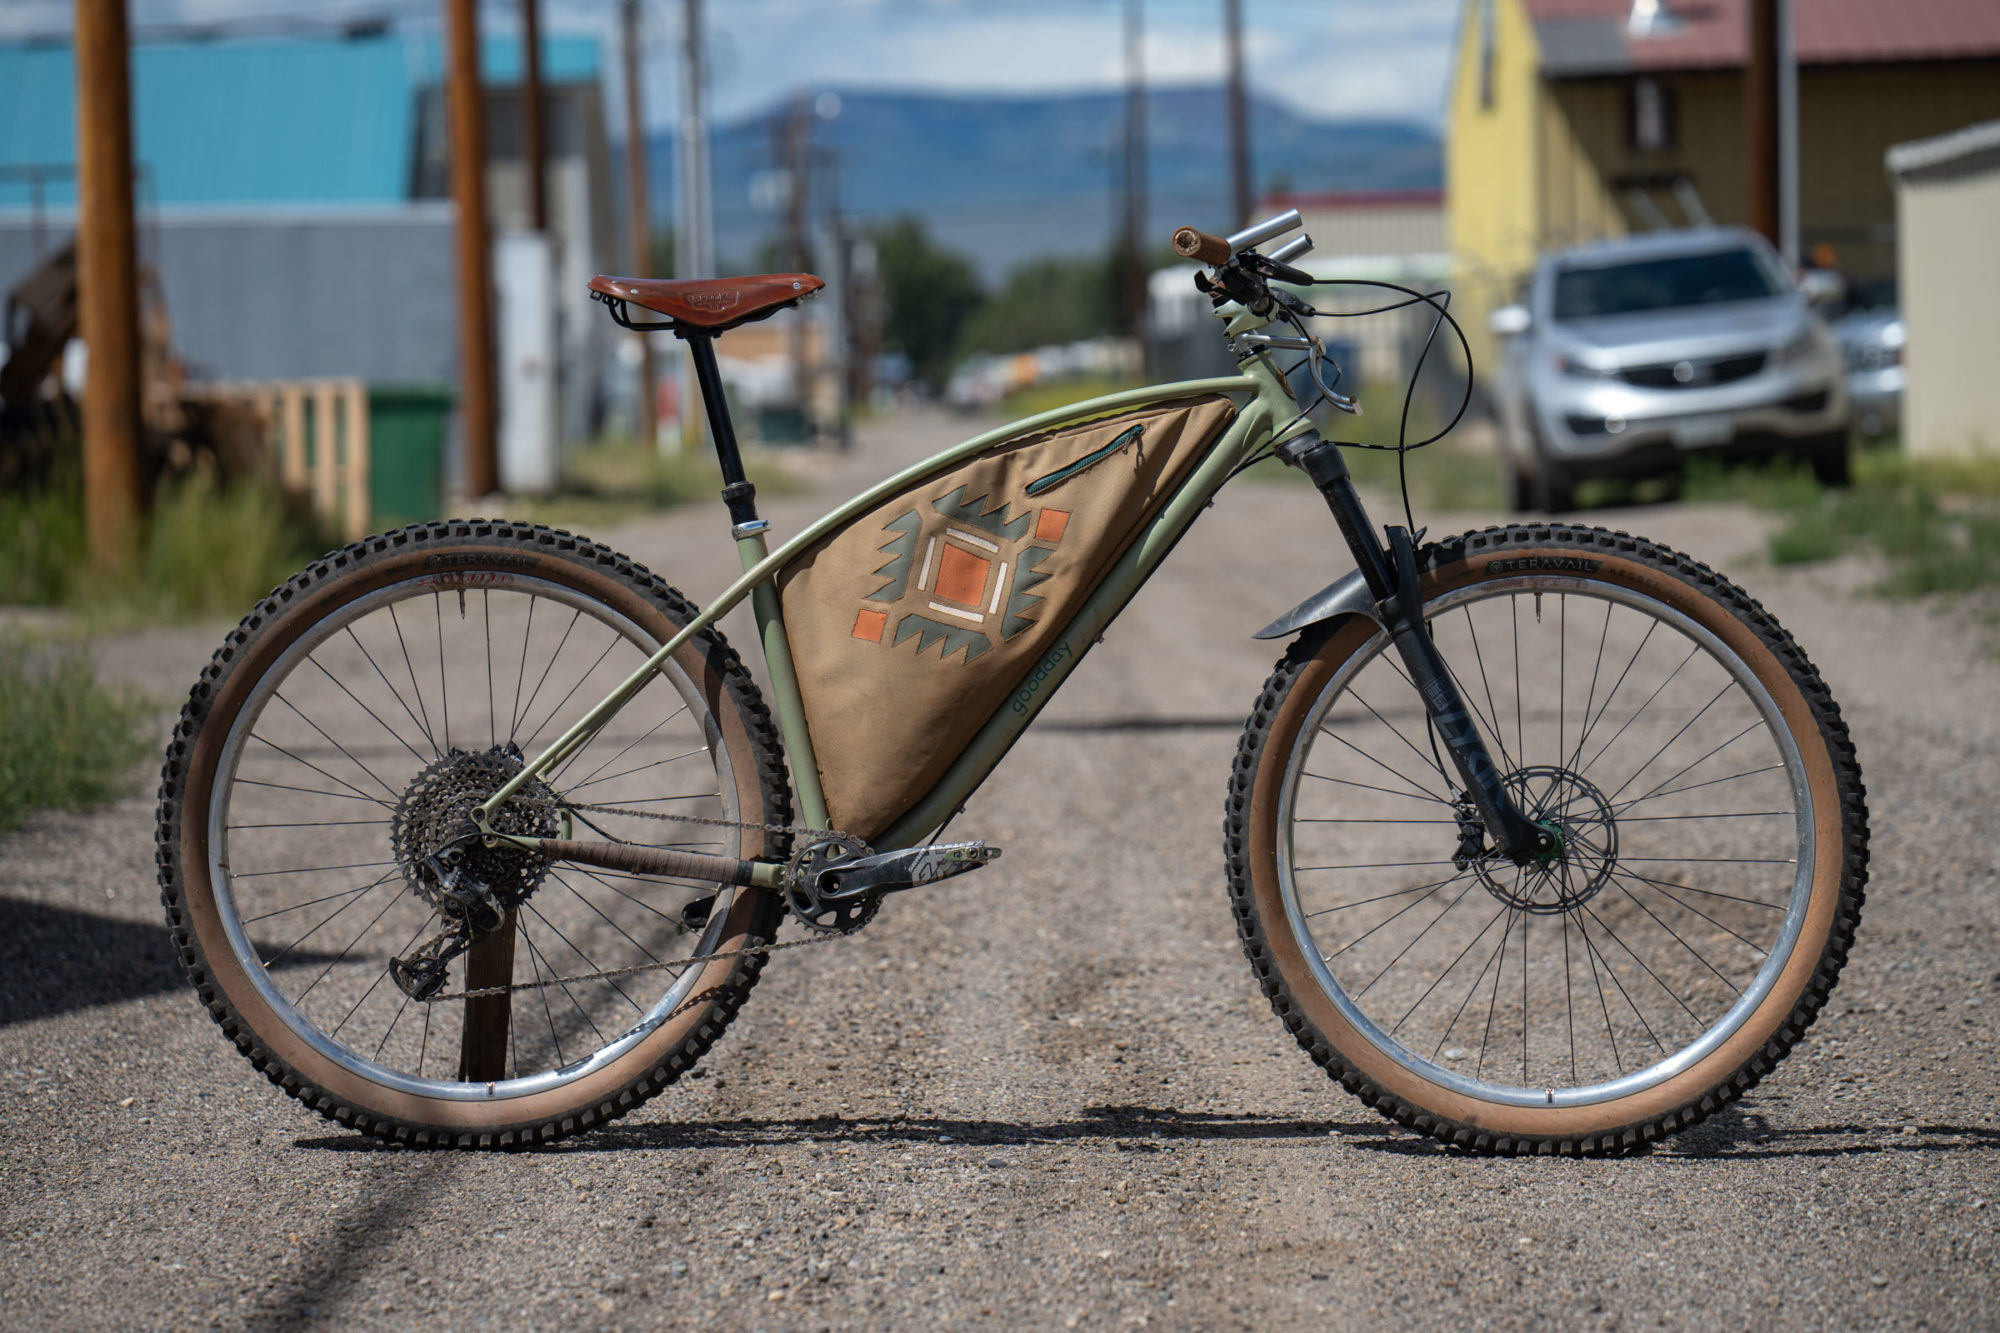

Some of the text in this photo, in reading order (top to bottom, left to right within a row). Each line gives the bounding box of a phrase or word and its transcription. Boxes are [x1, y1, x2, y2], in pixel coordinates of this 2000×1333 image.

[447, 553, 529, 567] TERAVAIL
[1505, 559, 1593, 572] TERAVAIL
[1011, 641, 1073, 716] goodday
